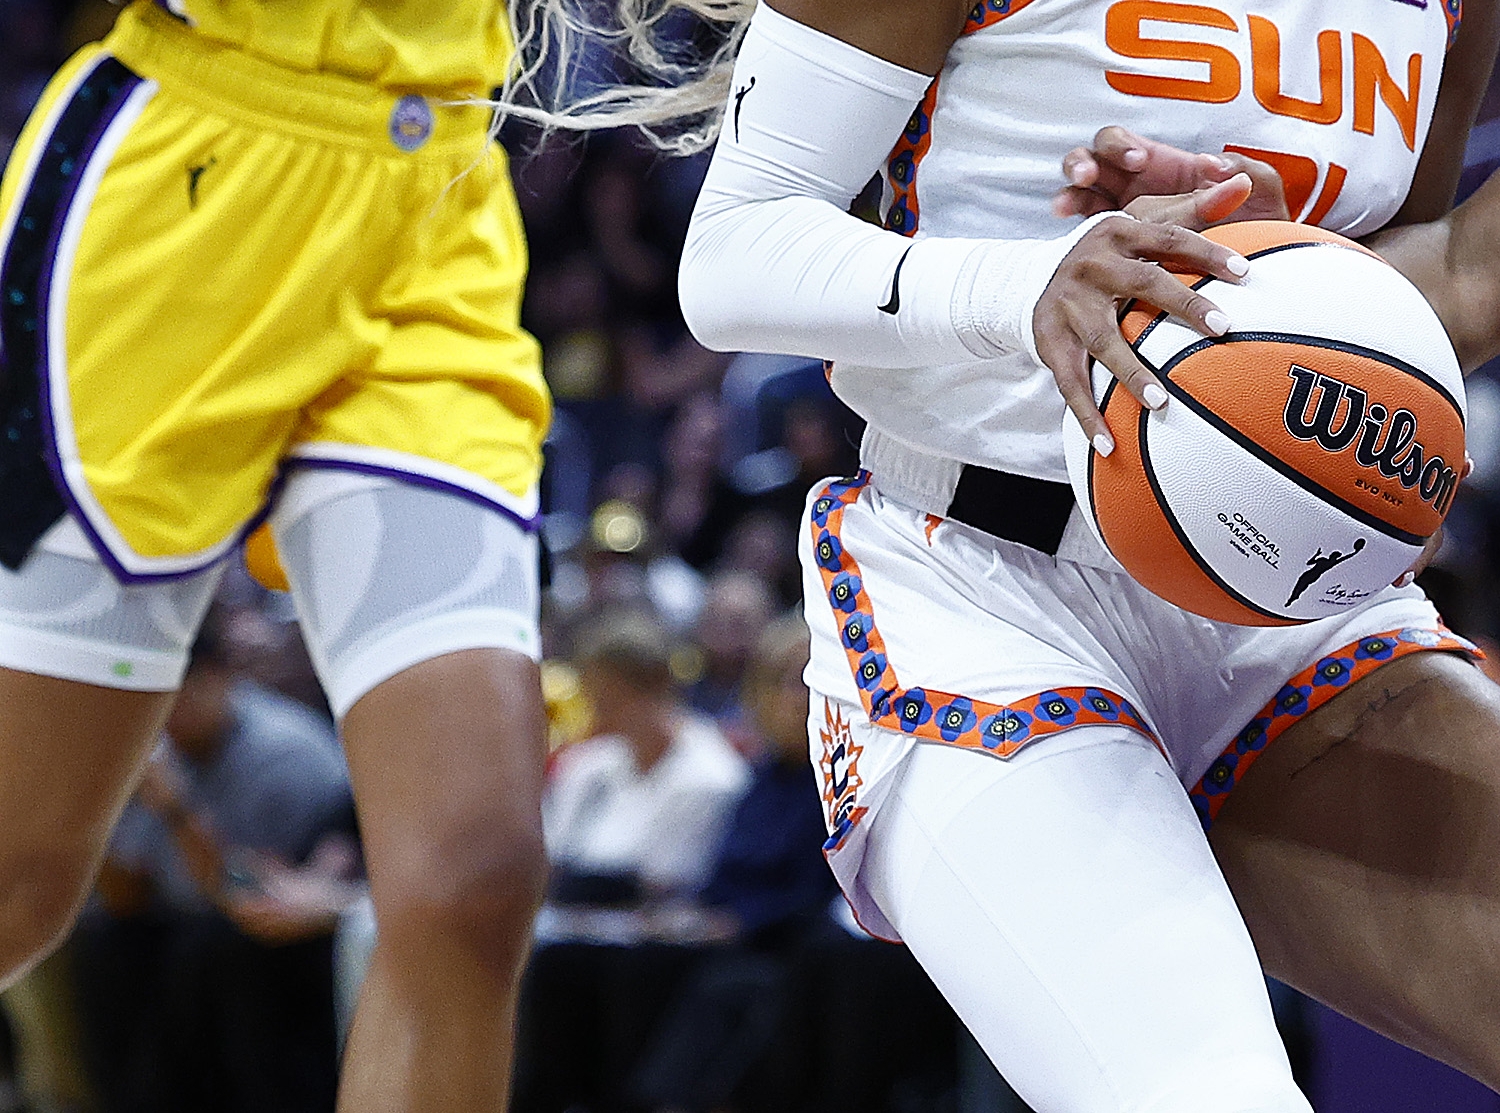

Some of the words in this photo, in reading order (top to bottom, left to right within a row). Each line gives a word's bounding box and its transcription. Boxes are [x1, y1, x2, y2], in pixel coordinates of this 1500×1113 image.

[1104, 0, 1422, 153] SUN
[1283, 362, 1457, 517] Wilson
[1217, 512, 1253, 546] GAME
[1250, 543, 1279, 570] BALL
[1232, 512, 1282, 559] OFFICIAL
